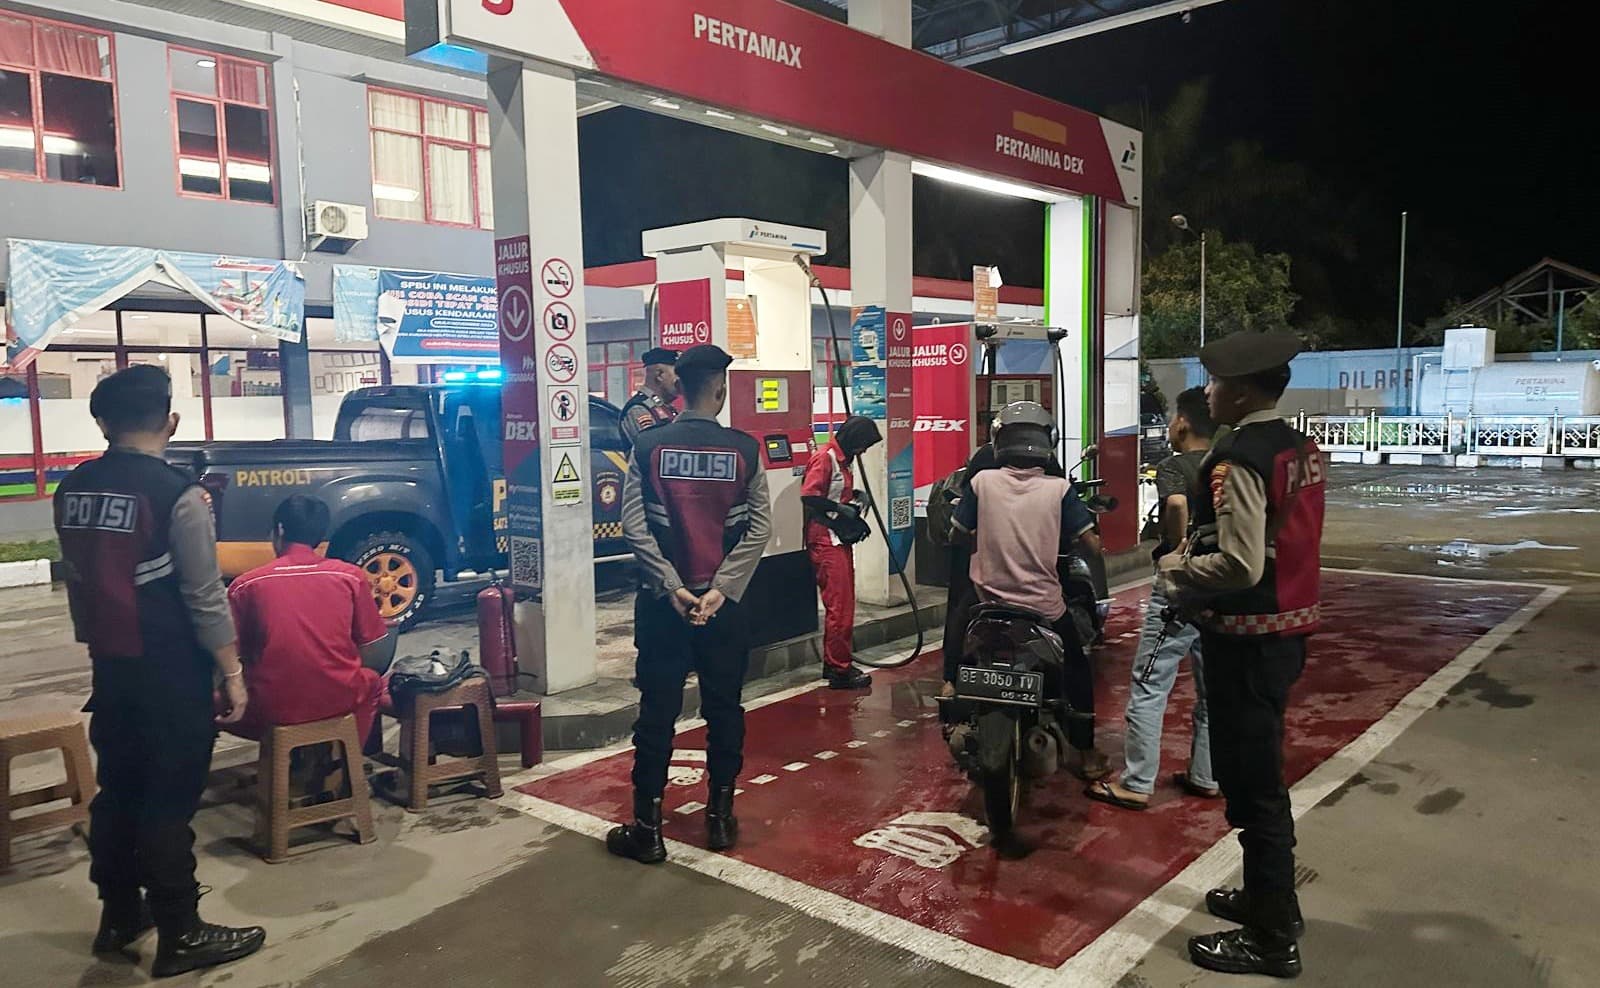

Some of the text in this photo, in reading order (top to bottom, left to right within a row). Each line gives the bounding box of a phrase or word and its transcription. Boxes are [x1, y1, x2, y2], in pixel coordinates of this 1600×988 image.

[694, 13, 802, 68] PERTAMAX
[995, 134, 1084, 175] PERTAMINA DEX
[498, 241, 529, 261] JALUR
[498, 260, 529, 276] KHUSUS
[401, 281, 430, 290] SPBU
[433, 282, 447, 291] INI
[435, 309, 496, 319] KENDARAAN
[663, 322, 693, 335] JALUR
[663, 335, 694, 346] KHUSUS
[889, 346, 911, 358] JALUR
[912, 345, 947, 357] JALUR
[912, 357, 948, 367] KHUSUS
[890, 420, 910, 428] DEX
[913, 419, 967, 431] DEX
[505, 421, 536, 441] DEX
[664, 452, 733, 478] POLISI
[960, 670, 1034, 690] BE 3050 TV
